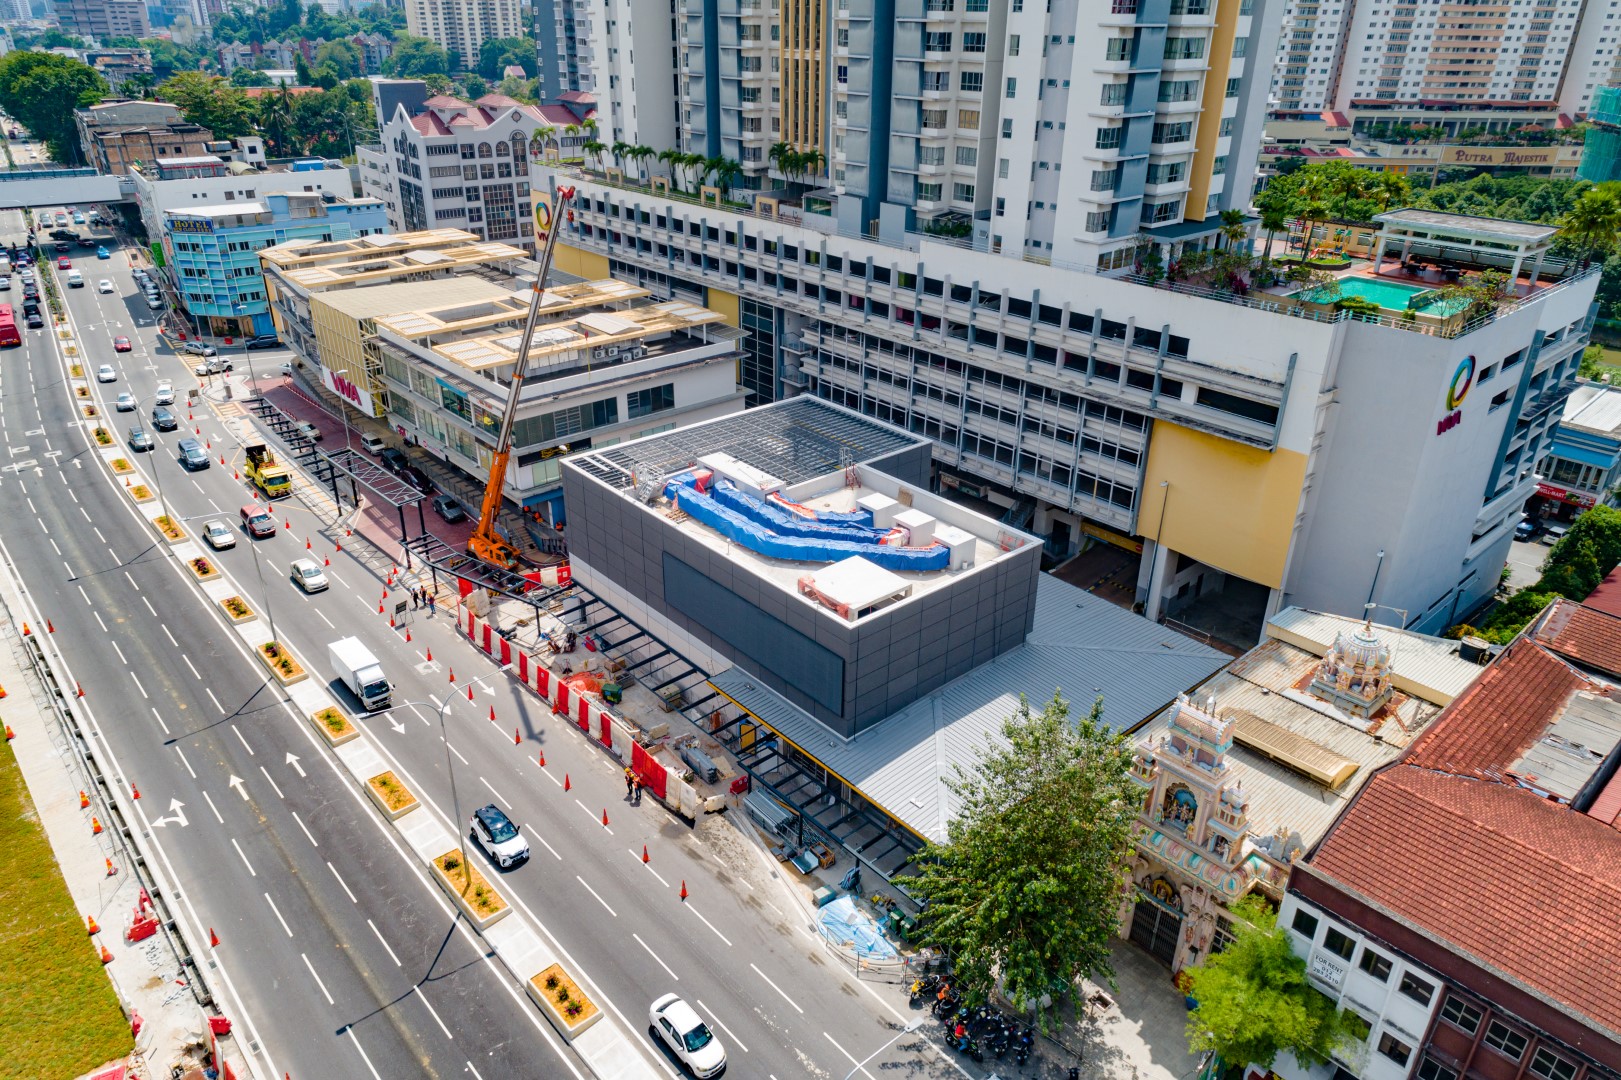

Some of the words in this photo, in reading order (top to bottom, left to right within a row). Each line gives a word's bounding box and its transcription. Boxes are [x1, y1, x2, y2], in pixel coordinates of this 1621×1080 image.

[1455, 150, 1493, 163] PUTRA
[1502, 152, 1549, 164] MAJESTIK
[174, 220, 209, 229] HOTEL
[330, 371, 362, 406] VIVA
[1315, 955, 1328, 965] FOR
[1328, 962, 1343, 974] RENT
